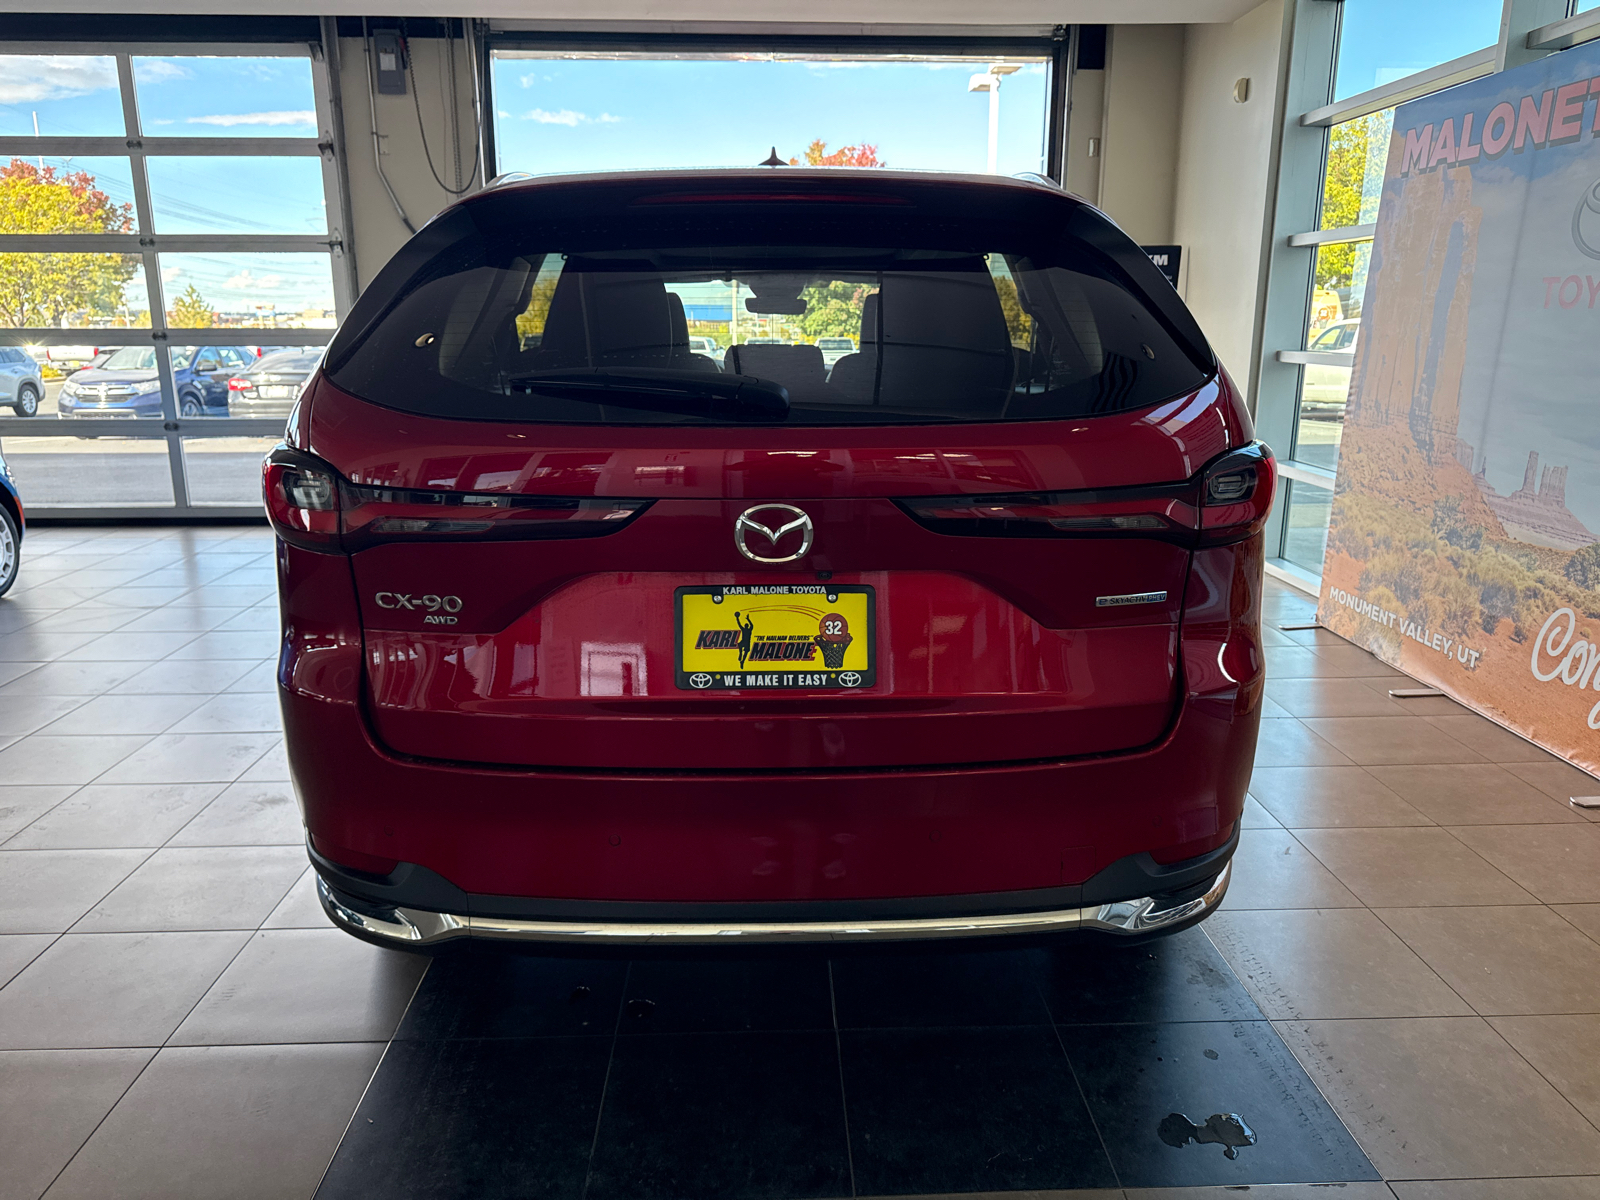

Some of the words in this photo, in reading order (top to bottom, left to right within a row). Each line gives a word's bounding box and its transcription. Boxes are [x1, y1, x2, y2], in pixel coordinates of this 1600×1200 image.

[722, 586, 748, 595] KARL
[750, 586, 789, 595] MALONE
[791, 585, 827, 594] TOYOTA
[375, 592, 463, 613] CX-90
[423, 615, 458, 625] AWD
[825, 621, 842, 635] 32
[1329, 586, 1397, 628] MONUMENT
[1400, 617, 1454, 660] VALLEY,
[1457, 645, 1480, 668] UT
[695, 630, 741, 649] KARL
[748, 642, 817, 661] MALONE
[724, 675, 741, 686] WE
[746, 674, 779, 686] MAKE
[783, 674, 794, 686] IT
[798, 674, 827, 685] EASY
